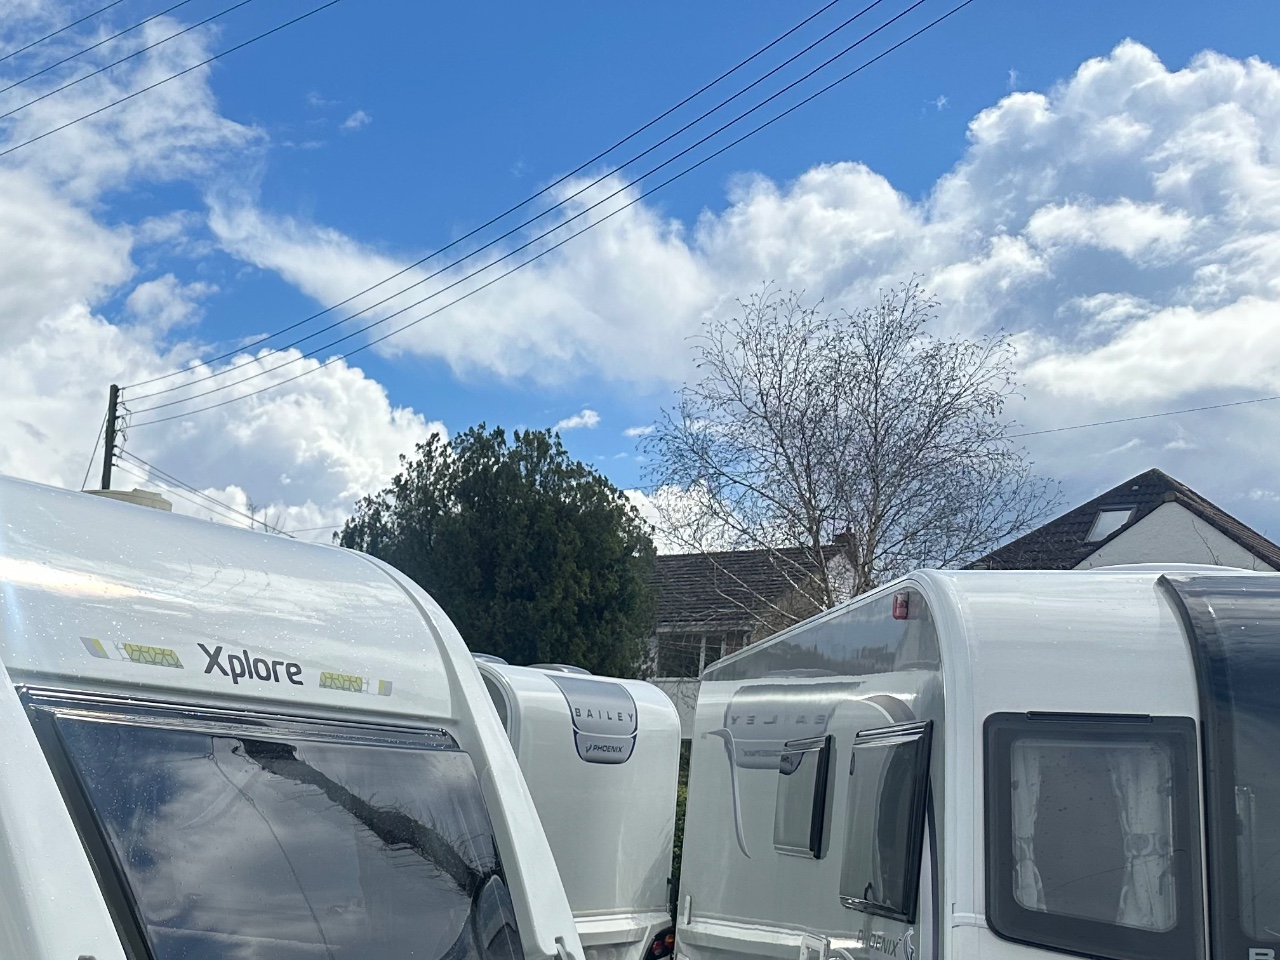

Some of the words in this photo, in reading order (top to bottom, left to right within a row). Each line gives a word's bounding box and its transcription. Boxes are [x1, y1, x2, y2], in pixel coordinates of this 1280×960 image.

[197, 643, 304, 685] Xplore
[574, 707, 634, 723] BAILEY
[592, 744, 625, 754] PHOENIX
